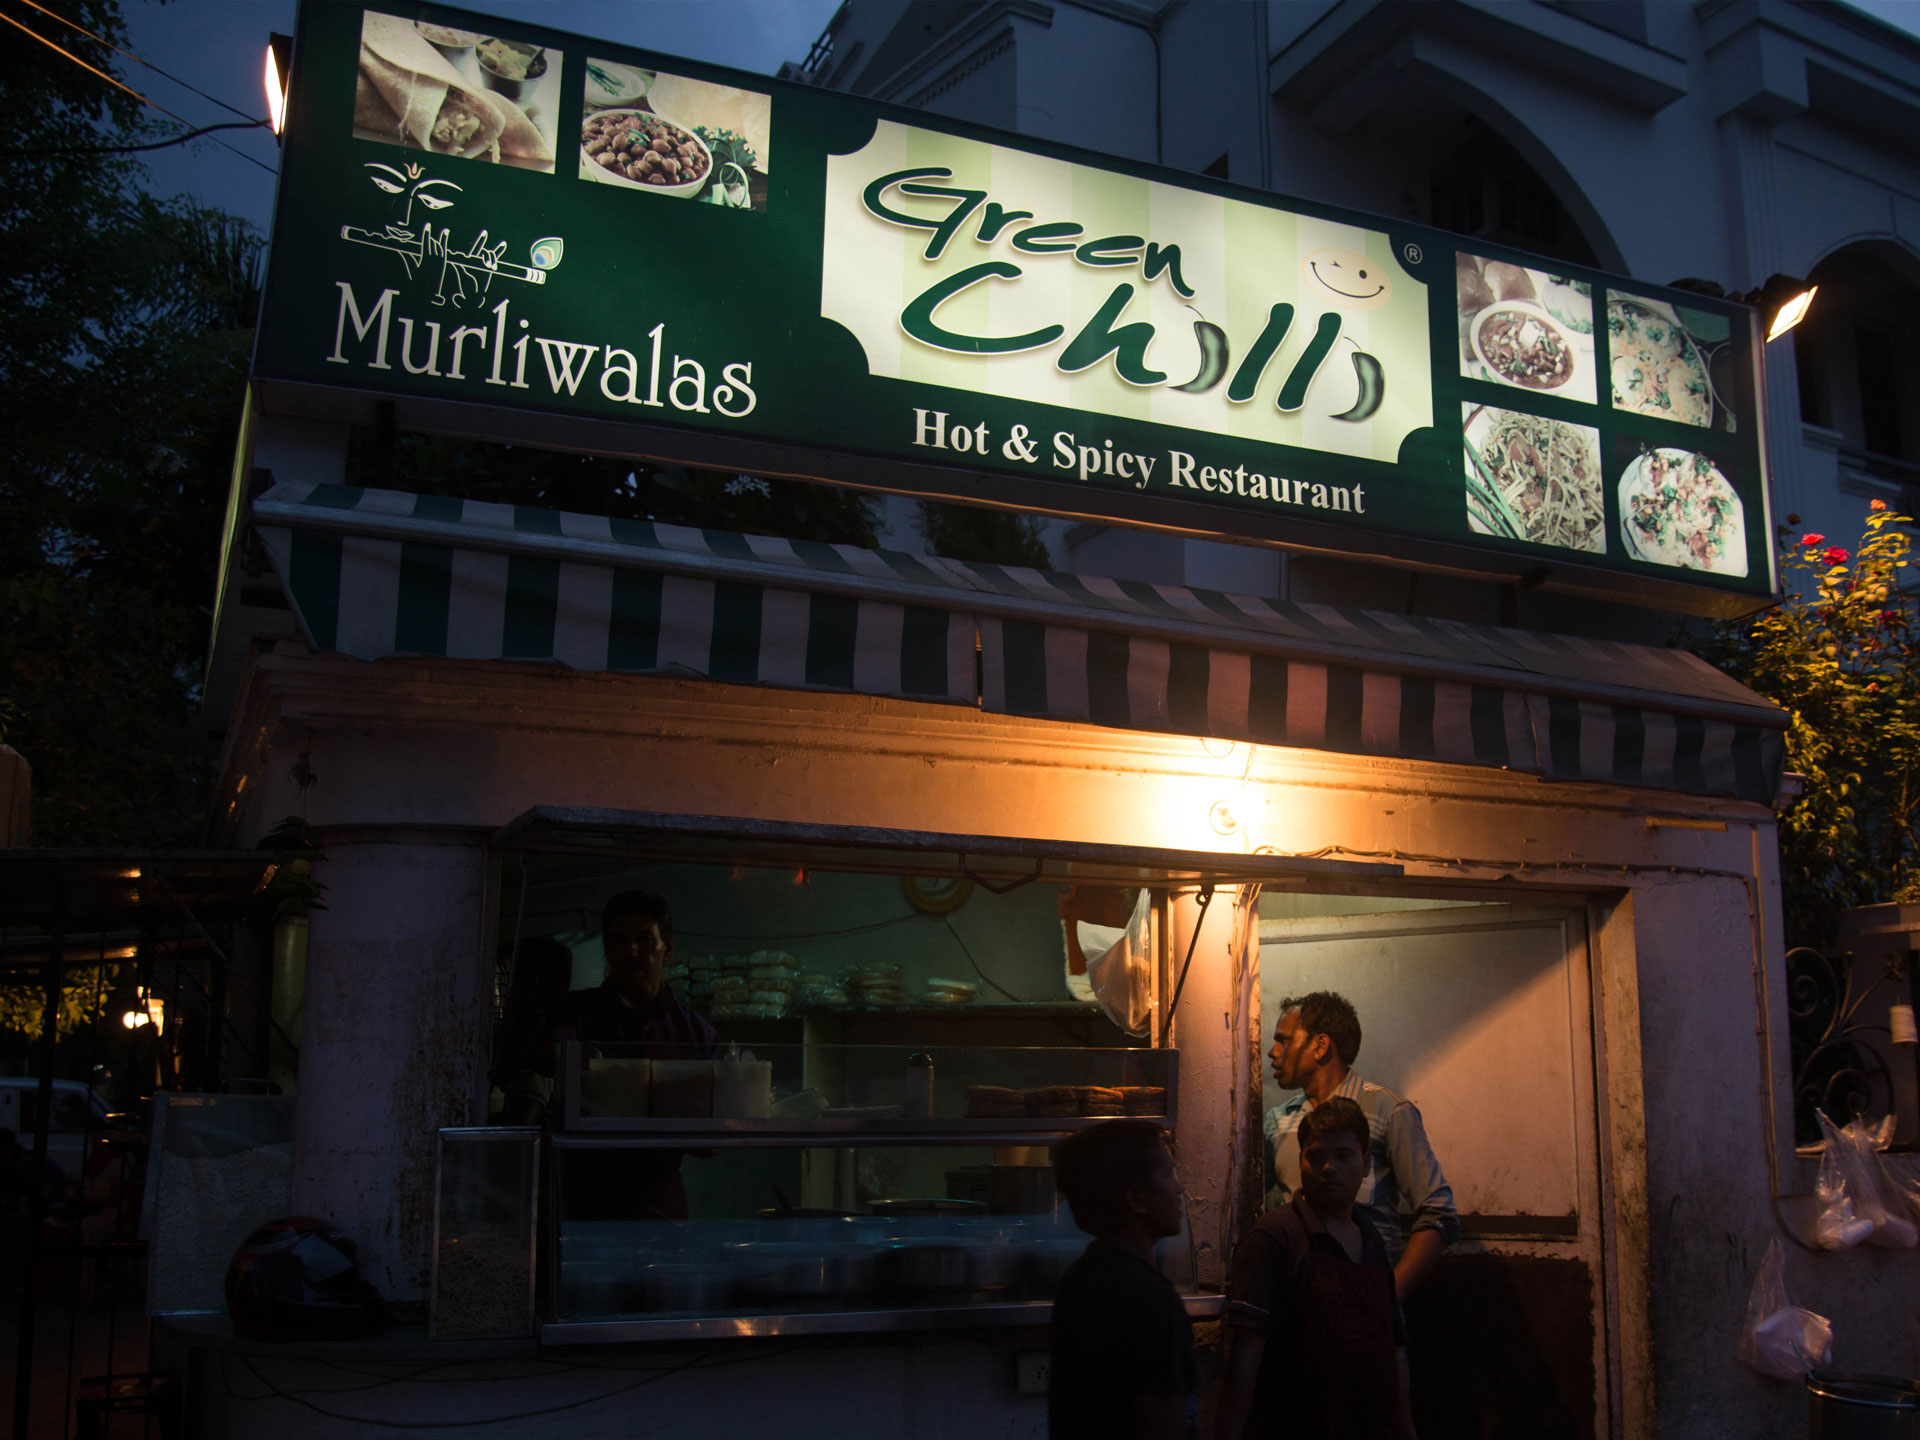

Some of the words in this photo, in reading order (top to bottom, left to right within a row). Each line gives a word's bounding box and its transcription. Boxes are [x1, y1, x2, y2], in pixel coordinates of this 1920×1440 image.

[862, 167, 1195, 298] Green
[326, 281, 757, 418] Murliwalas
[912, 407, 990, 456] Hot
[1002, 424, 1039, 463] &
[1053, 432, 1157, 489] Spicy
[1168, 450, 1366, 514] Restaurant
